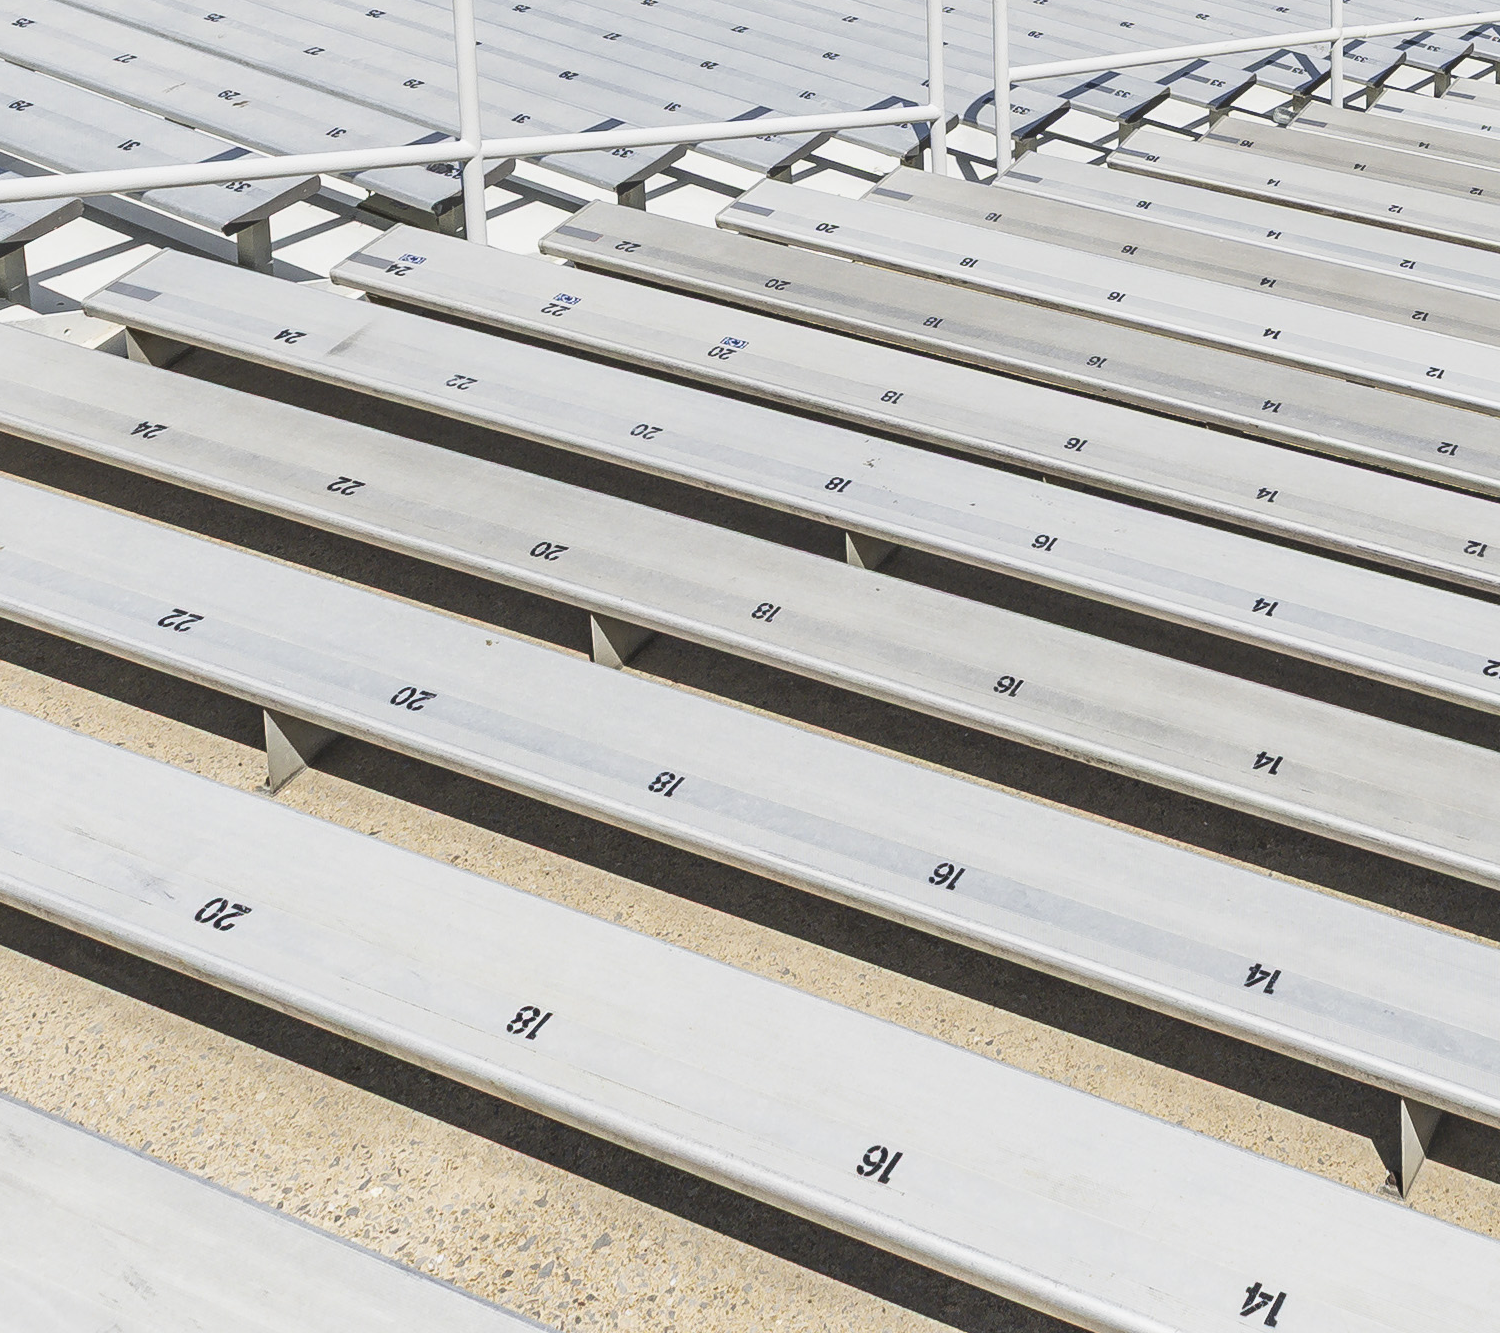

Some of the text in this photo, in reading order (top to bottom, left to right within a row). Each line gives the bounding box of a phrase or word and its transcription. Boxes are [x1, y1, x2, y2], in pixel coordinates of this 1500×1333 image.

[157, 608, 205, 633] 22
[389, 686, 438, 712] 20
[1252, 750, 1284, 776] 14
[194, 897, 253, 932] 20
[1243, 962, 1282, 995] 14
[506, 1005, 554, 1041] 18
[856, 1144, 904, 1185] 16
[1239, 1281, 1287, 1328] 14
